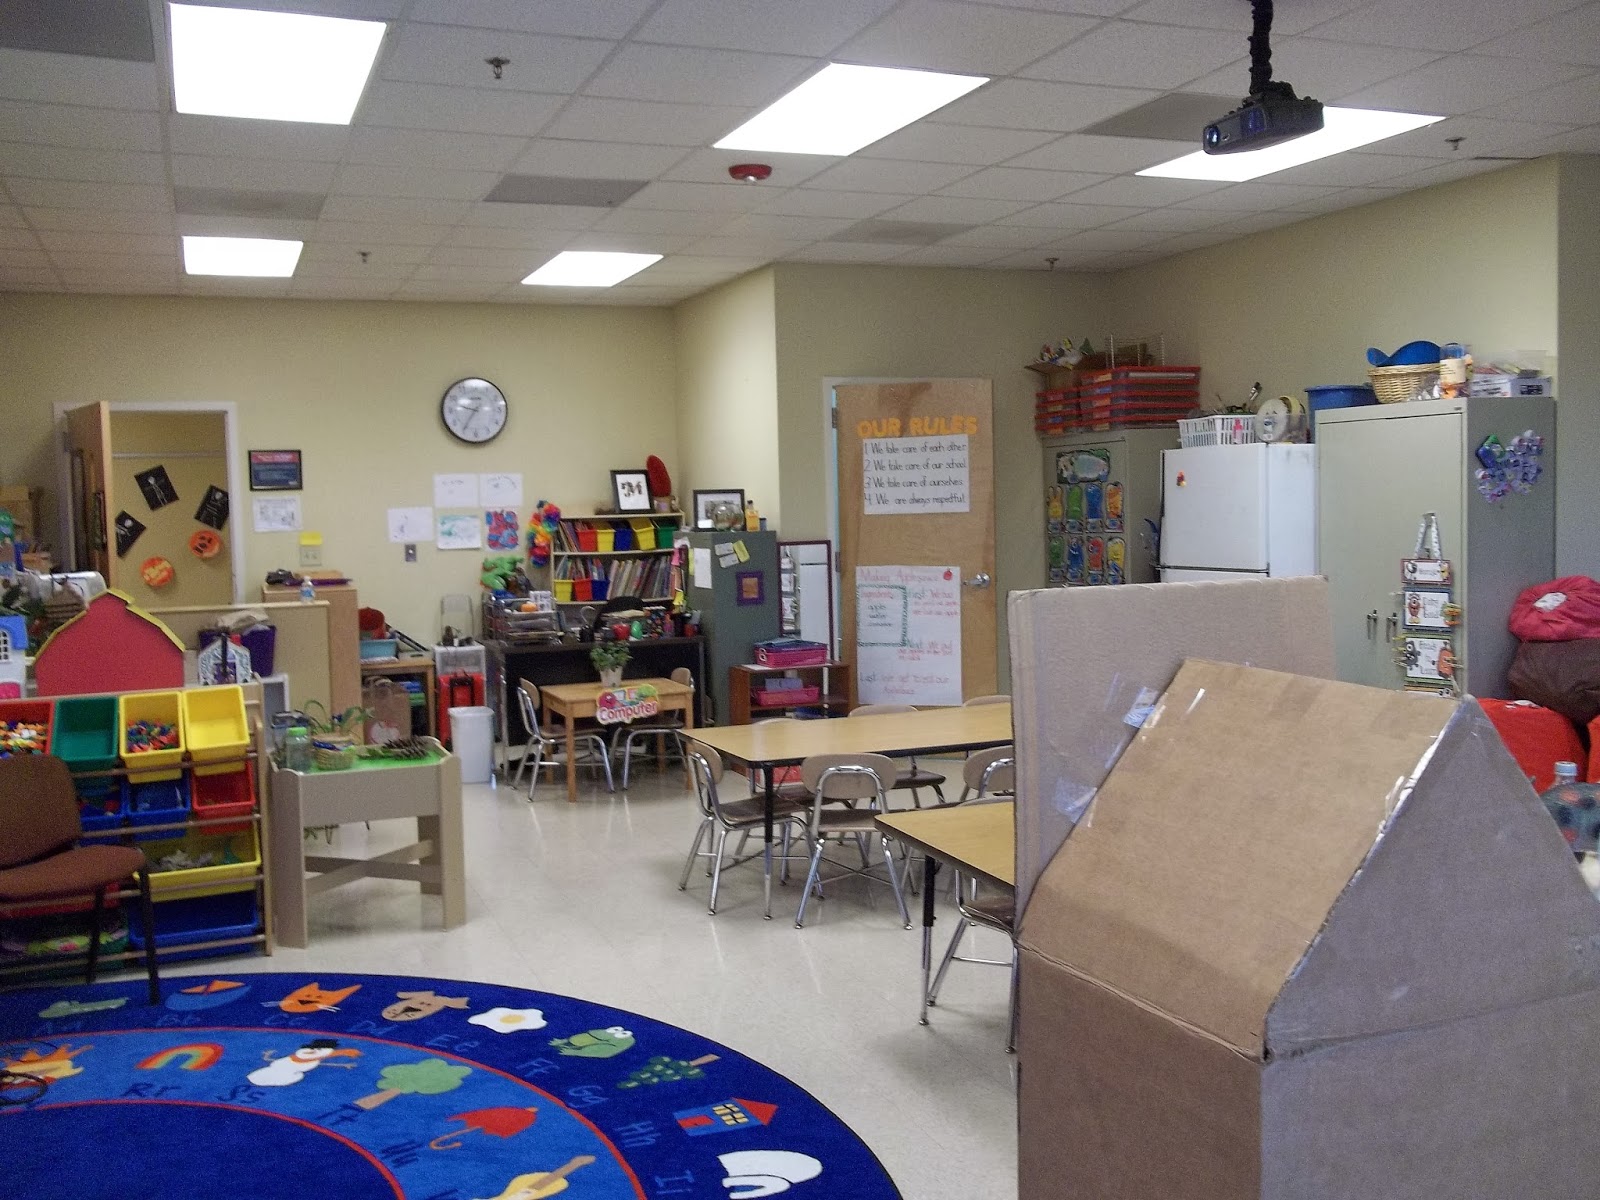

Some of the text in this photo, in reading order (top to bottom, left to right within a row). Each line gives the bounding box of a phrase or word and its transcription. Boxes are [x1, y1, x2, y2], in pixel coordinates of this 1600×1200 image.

[857, 416, 978, 437] OUR RULES
[871, 442, 884, 454] We
[920, 441, 929, 453] of
[873, 459, 886, 472] We
[888, 459, 903, 471] take
[905, 463, 921, 471] care
[922, 458, 930, 469] of
[931, 462, 944, 470] our
[873, 475, 885, 488] We
[919, 475, 927, 487] of
[875, 493, 889, 505] We
[599, 701, 657, 722] Computer
[120, 1082, 181, 1097] Rr
